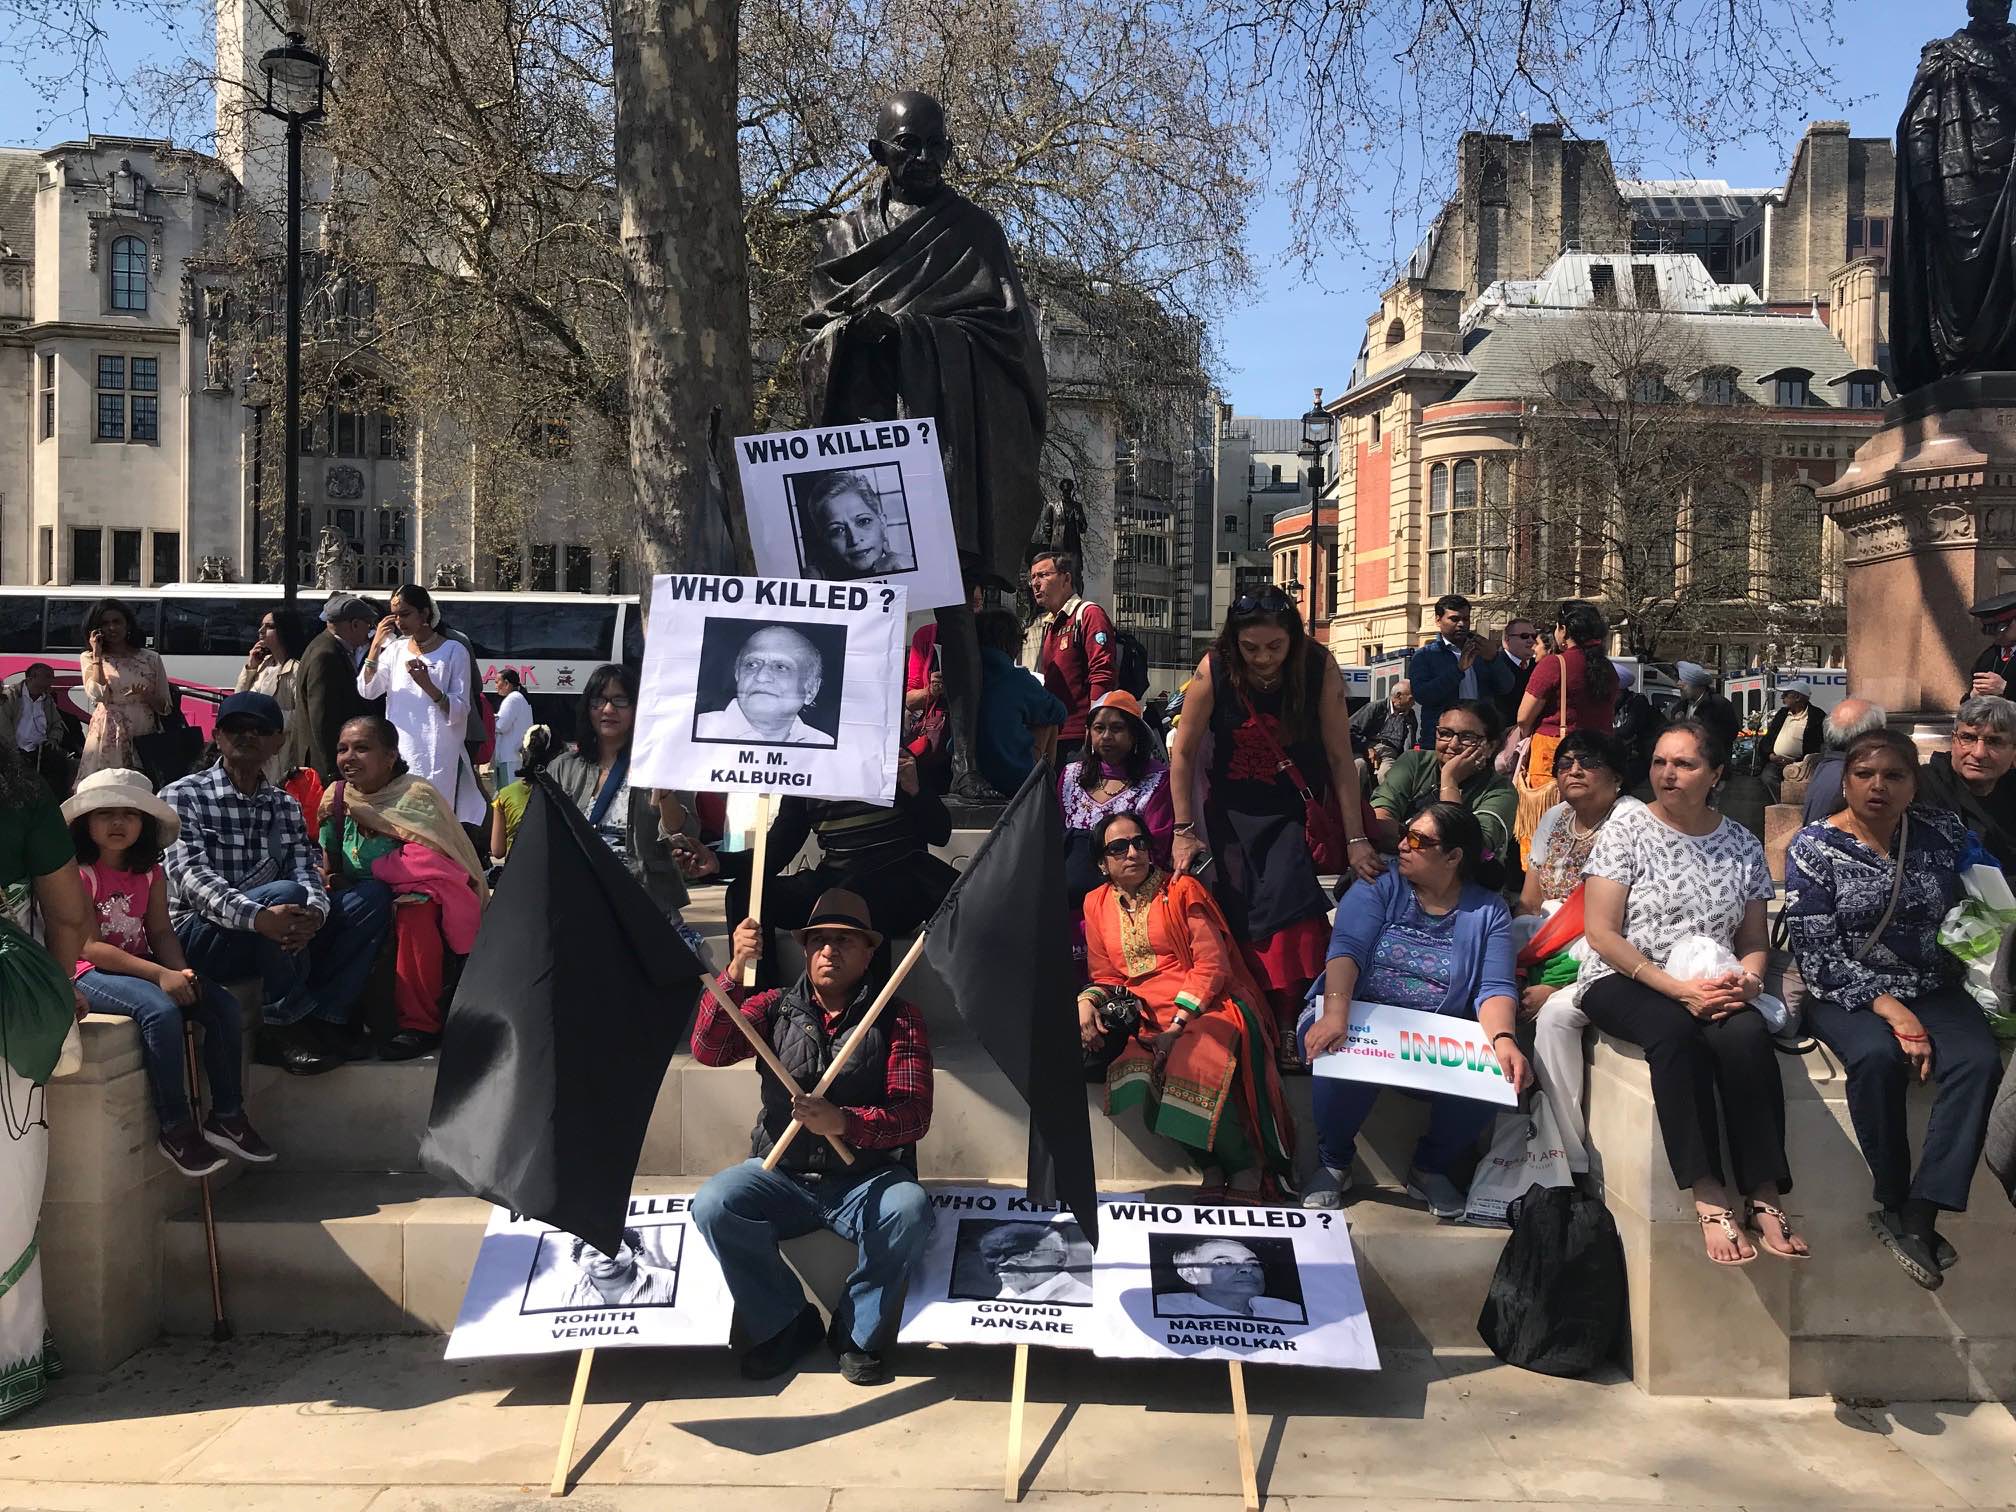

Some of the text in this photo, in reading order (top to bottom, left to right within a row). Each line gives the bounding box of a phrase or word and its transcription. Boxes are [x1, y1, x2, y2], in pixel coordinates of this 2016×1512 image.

[744, 422, 930, 464] WHO KILLED ?
[671, 576, 895, 613] WHO KILLED ?
[738, 751, 788, 765] M. M.
[710, 769, 812, 787] KALBURGI
[1400, 1030, 1503, 1076] INDIA
[929, 1195, 997, 1210] WHO
[1109, 1204, 1333, 1230] WHO KILLED ?
[554, 1312, 636, 1325] ROHITH
[977, 1304, 1063, 1317] GOVIND
[551, 1326, 640, 1339] VEMULA
[970, 1316, 1074, 1334] PANSARE
[1169, 1320, 1286, 1336] NARENDRA
[1166, 1334, 1298, 1351] DABHOLKAR
